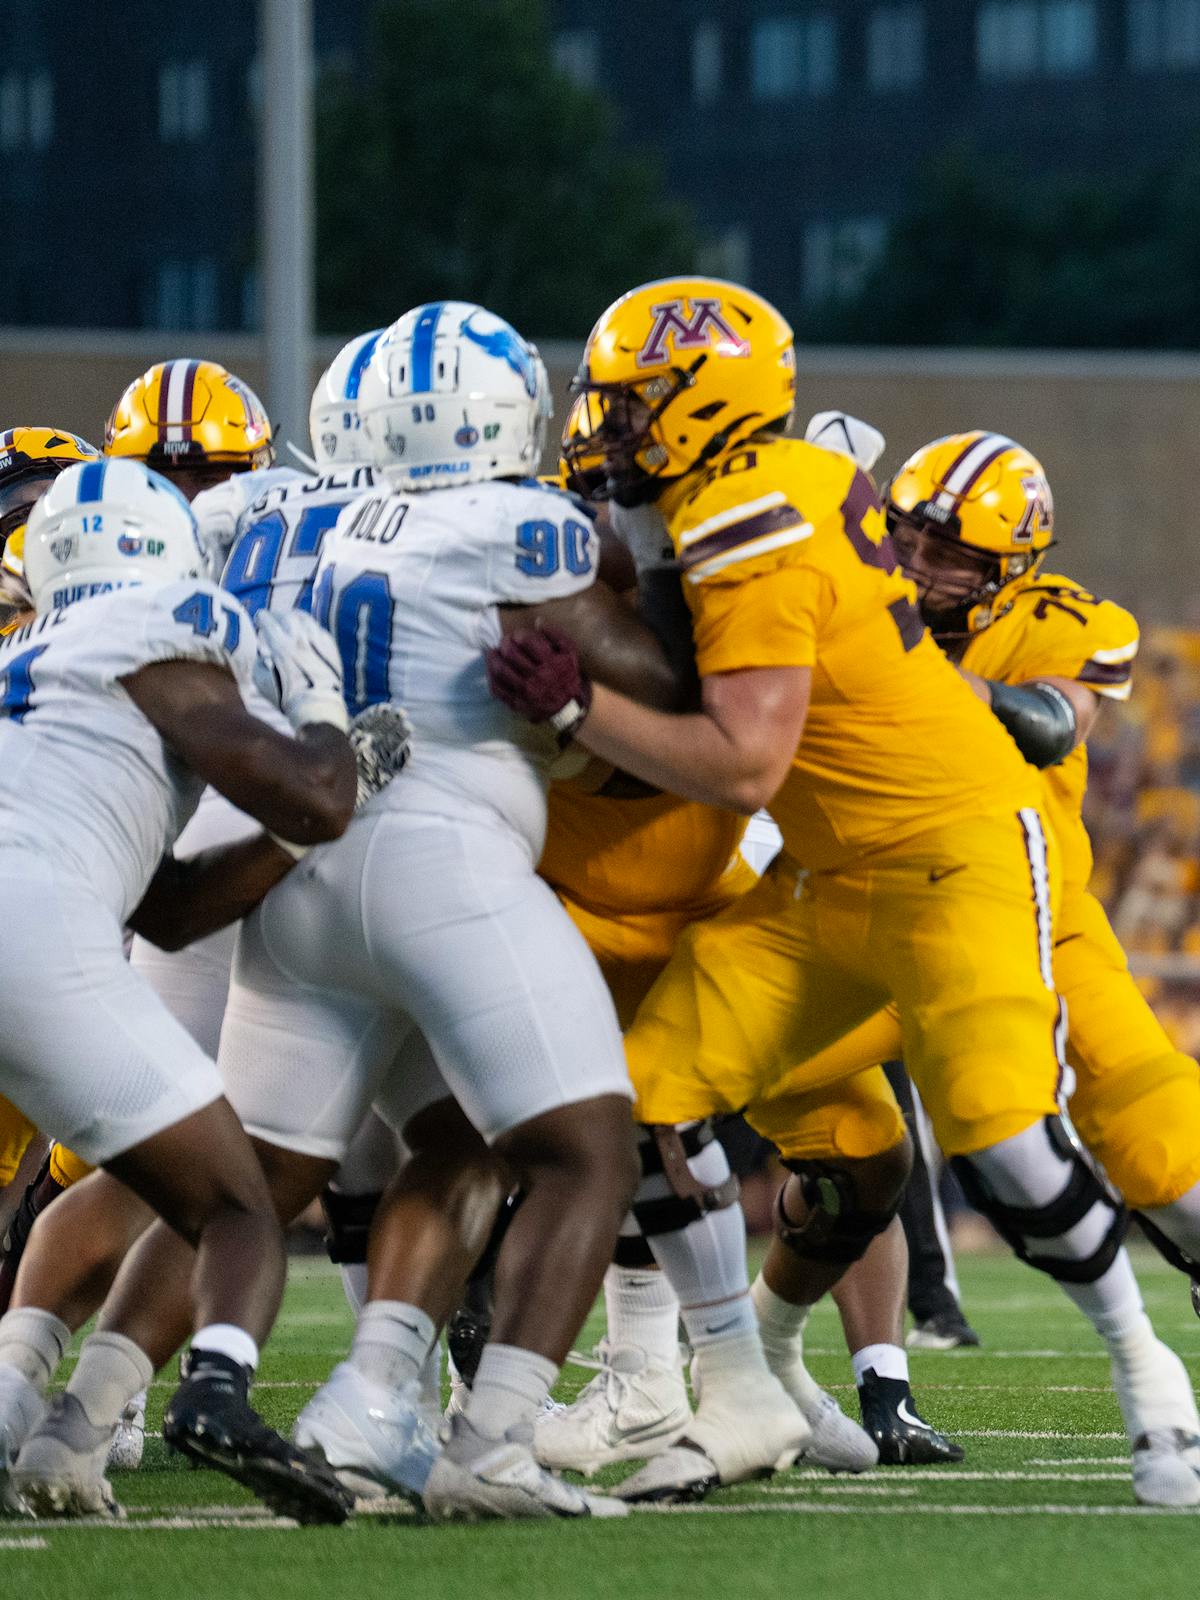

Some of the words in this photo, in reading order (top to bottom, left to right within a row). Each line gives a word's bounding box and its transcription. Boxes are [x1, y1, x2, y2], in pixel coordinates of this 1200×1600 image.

[411, 404, 435, 423] 90
[408, 461, 471, 480] BUFFALO
[81, 514, 104, 533] 12
[147, 538, 166, 557] GP
[515, 519, 594, 578] 90
